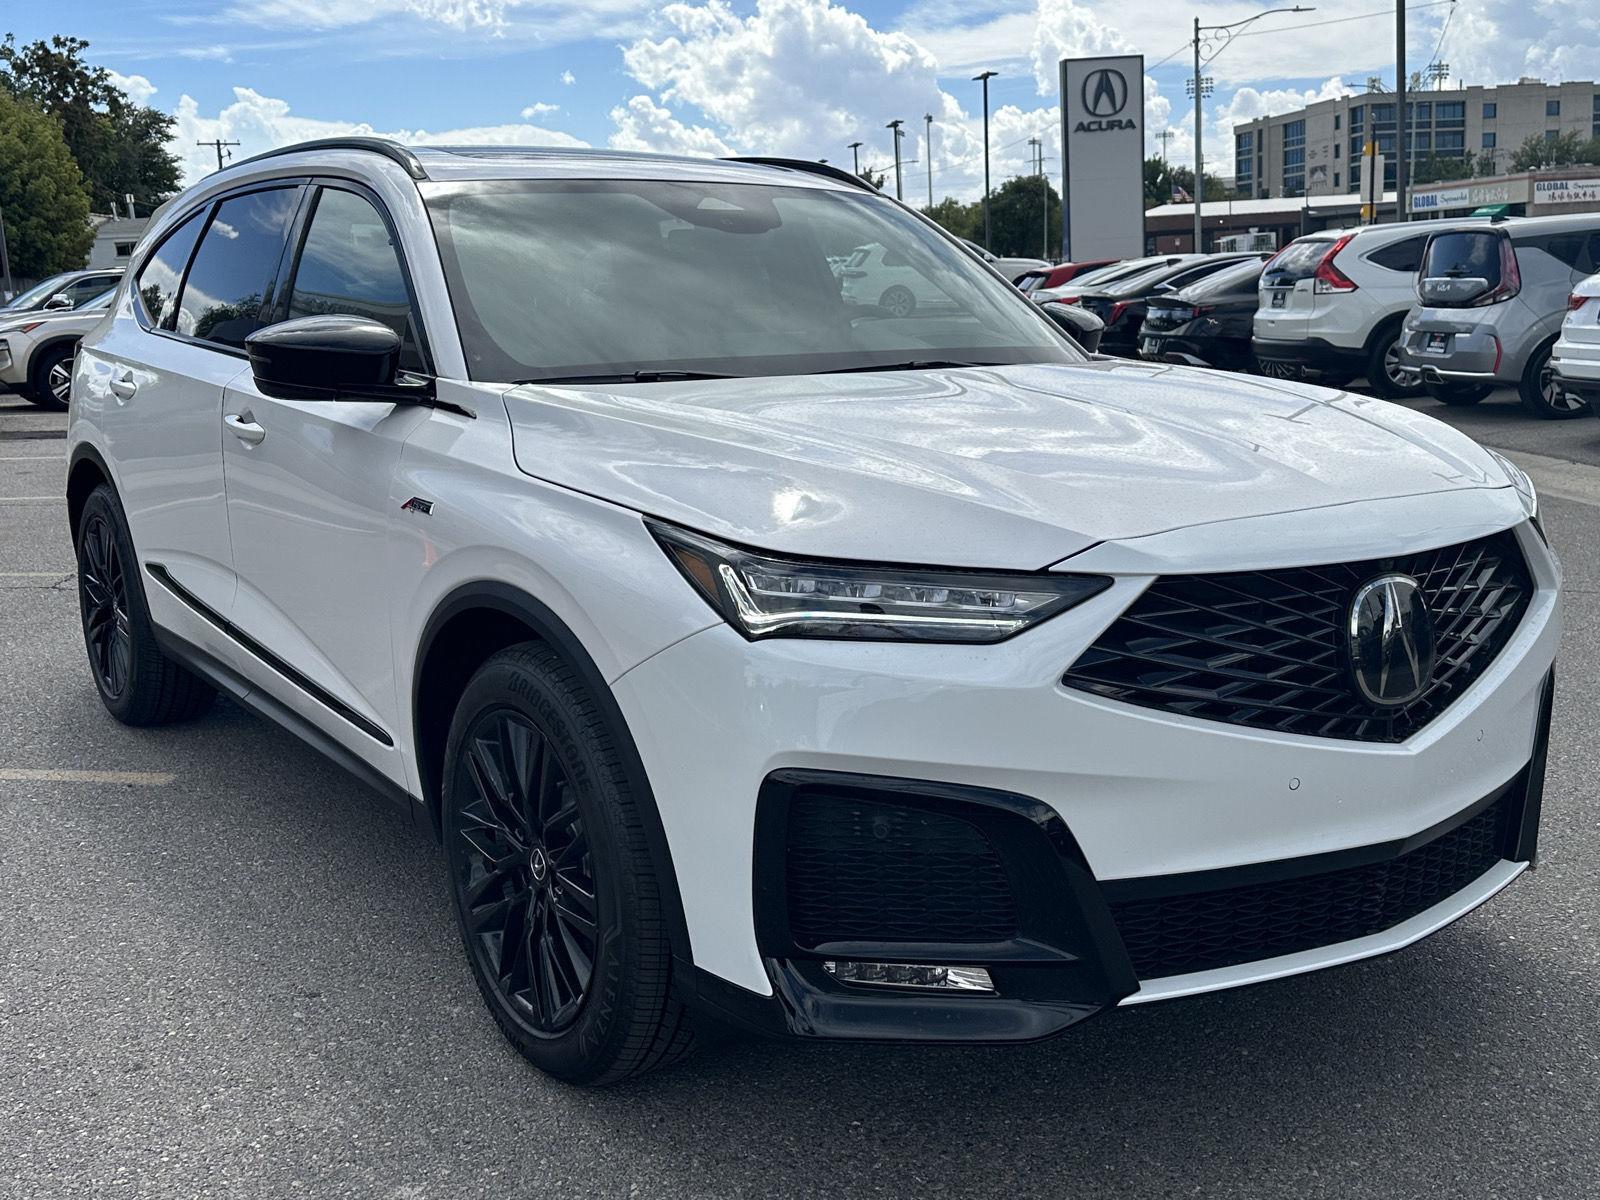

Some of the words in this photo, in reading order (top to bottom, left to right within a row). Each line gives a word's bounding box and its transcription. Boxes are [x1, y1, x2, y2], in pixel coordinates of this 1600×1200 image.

[1074, 118, 1137, 133] ACURA
[1536, 182, 1569, 192] GLOBAL
[1413, 194, 1438, 208] GLOBAL
[508, 670, 594, 793] BRIDGESTONE
[588, 951, 620, 1048] ALENZA
